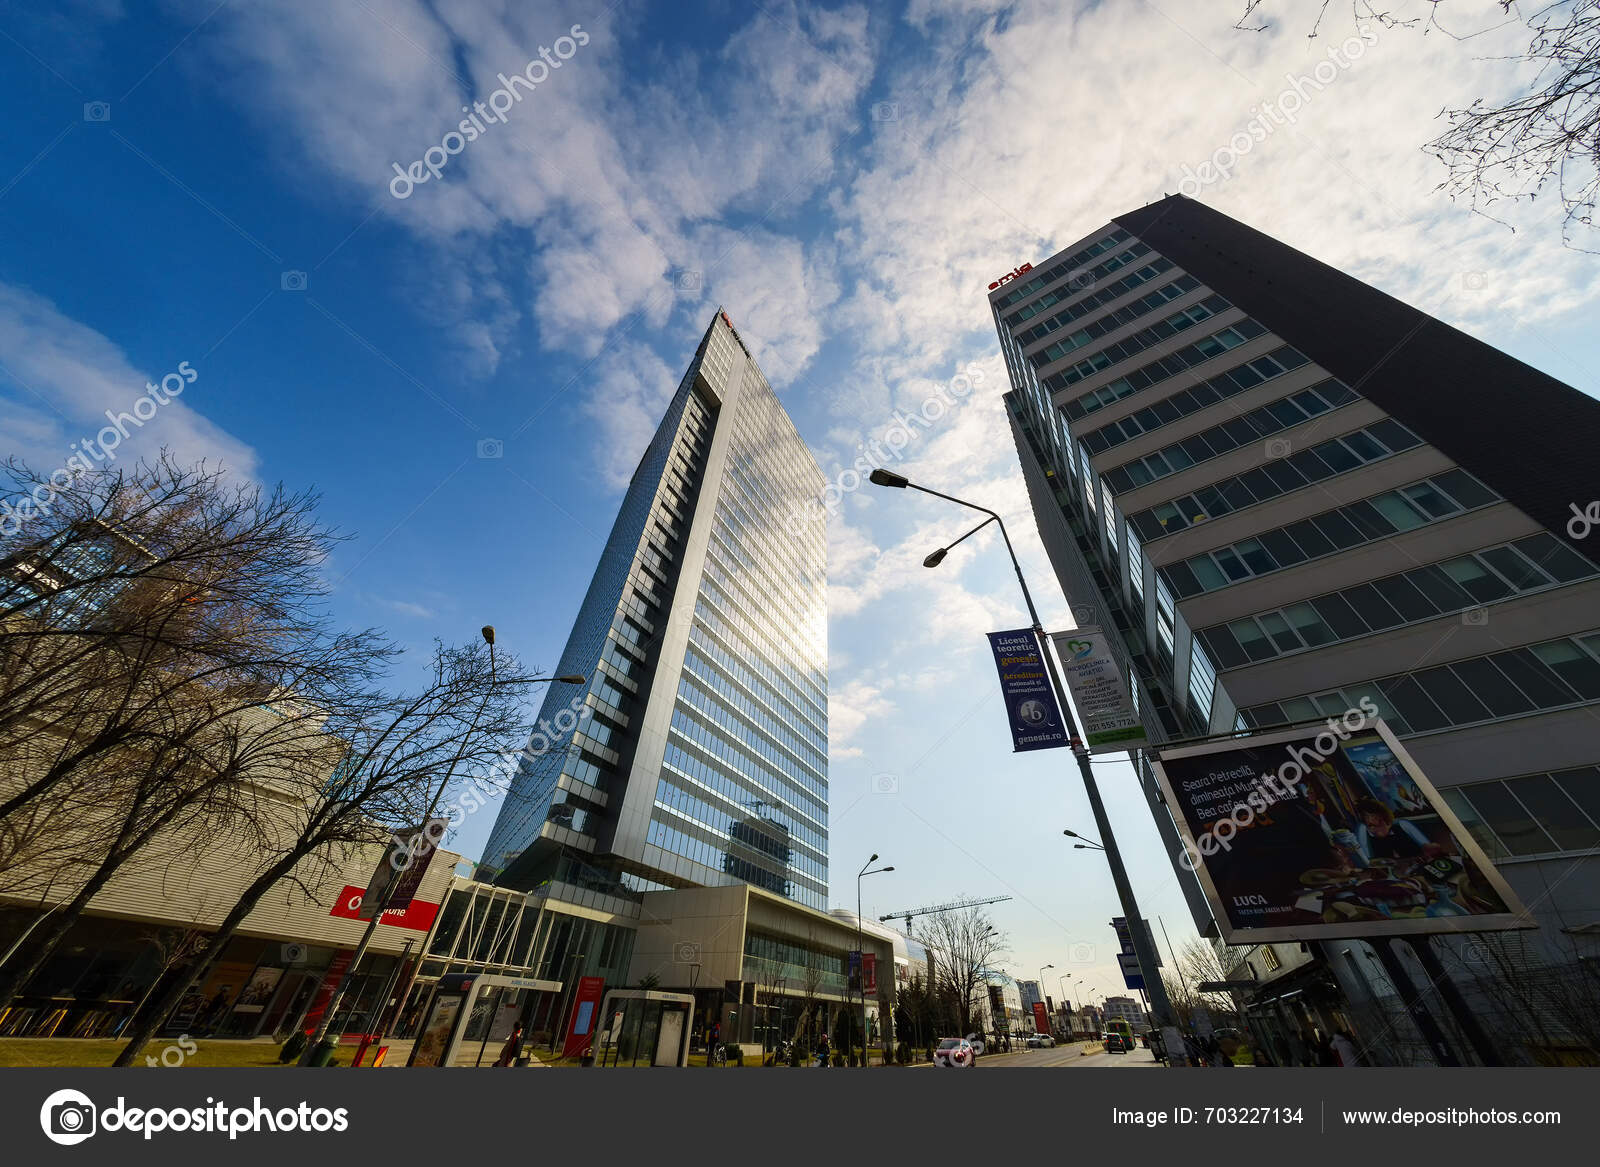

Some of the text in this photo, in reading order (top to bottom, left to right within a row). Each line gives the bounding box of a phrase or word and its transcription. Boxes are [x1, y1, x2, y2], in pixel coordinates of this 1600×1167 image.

[998, 635, 1029, 645] Liceul
[996, 644, 1035, 653] teoretic
[1000, 655, 1039, 666] genesis
[1003, 671, 1044, 681] Acreditare
[1018, 732, 1062, 745] genesis.ro
[1182, 777, 1209, 792] Seara
[1196, 807, 1217, 820] Bea
[1232, 894, 1268, 907] LUCA
